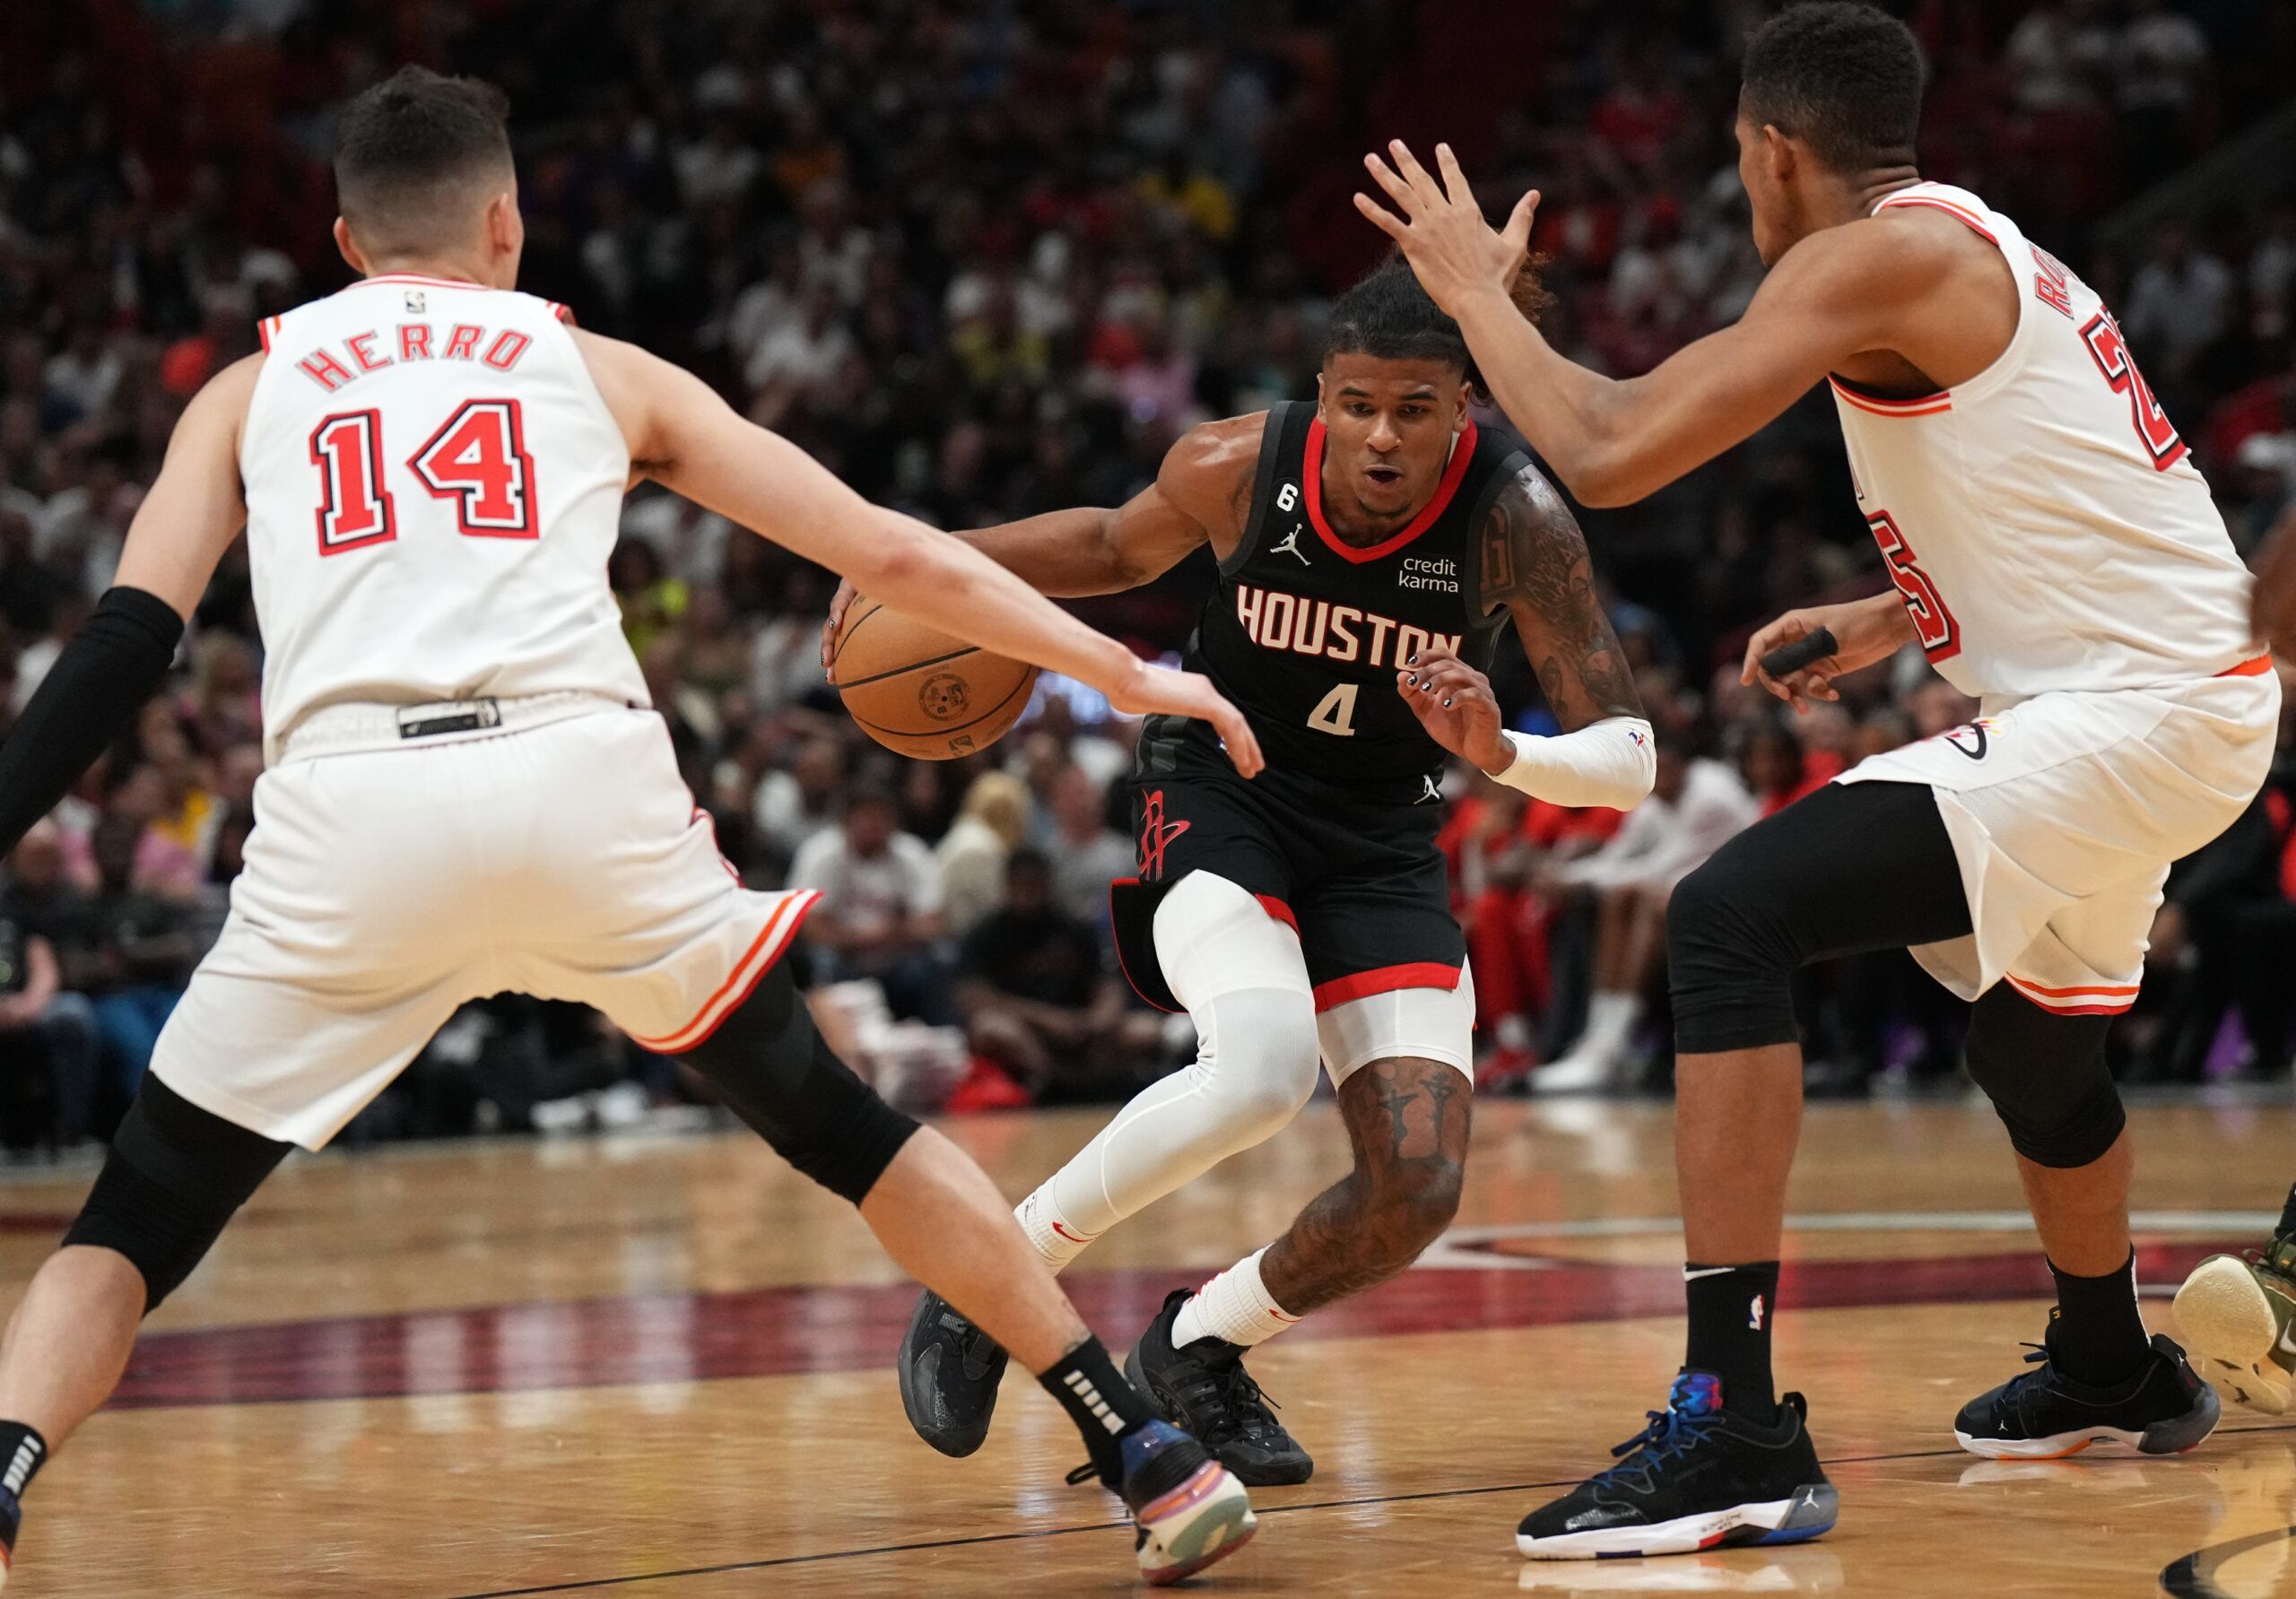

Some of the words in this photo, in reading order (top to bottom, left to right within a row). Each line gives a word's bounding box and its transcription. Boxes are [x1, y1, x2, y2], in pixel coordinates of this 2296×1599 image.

[295, 323, 533, 393] HERRO
[309, 398, 539, 556] 14
[1276, 482, 1299, 512] 6
[1399, 570, 1458, 593] karma
[1404, 558, 1457, 576] credit
[1306, 683, 1359, 736] 4
